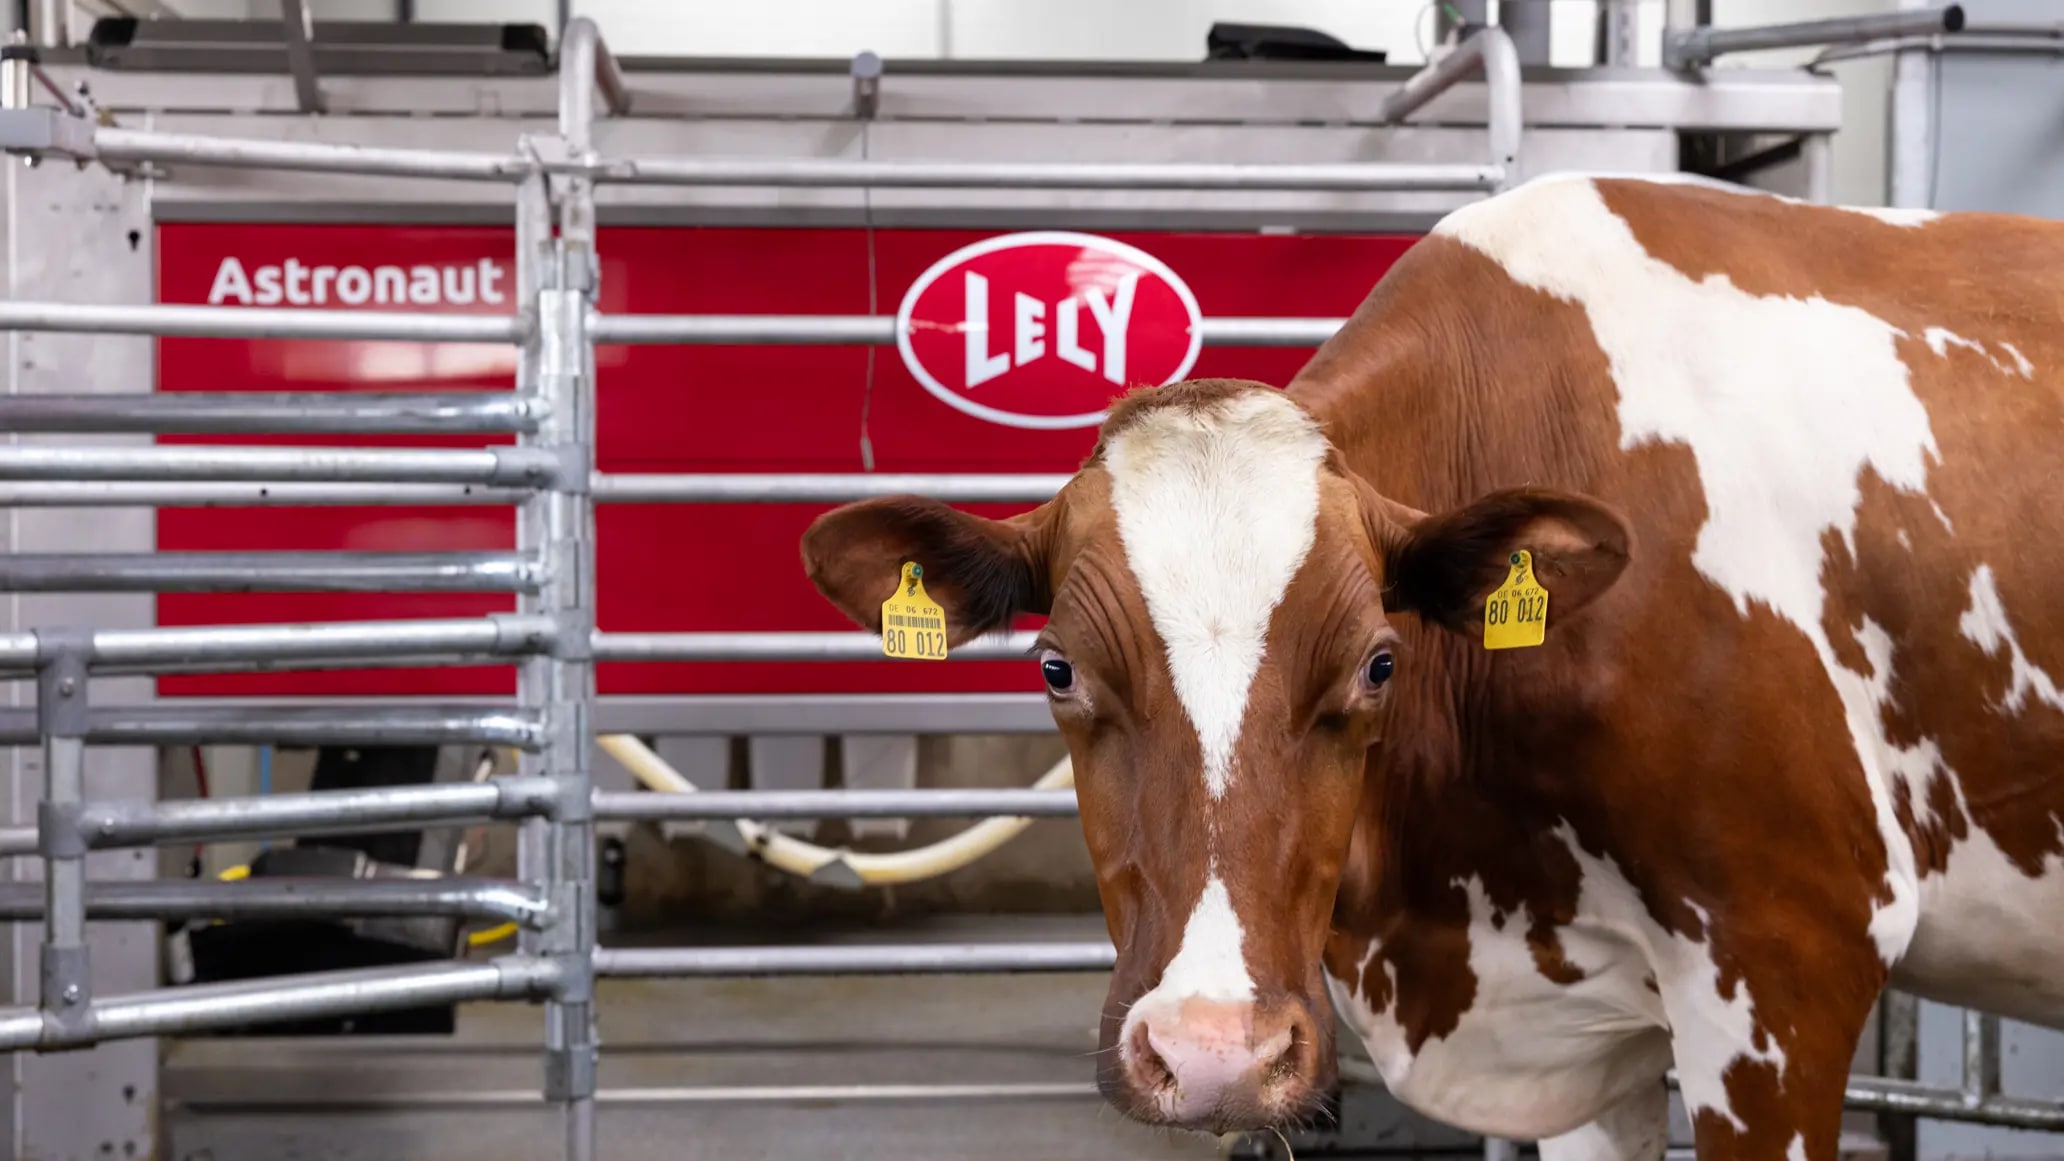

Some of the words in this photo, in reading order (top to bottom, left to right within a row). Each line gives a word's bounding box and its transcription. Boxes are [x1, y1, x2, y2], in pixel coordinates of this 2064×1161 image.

[207, 256, 505, 305] Astronaut
[965, 269, 1139, 389] LELY
[889, 604, 898, 613] DE
[906, 605, 917, 614] 06
[923, 607, 938, 616] 672
[1488, 599, 1509, 625] 80
[1517, 596, 1544, 623] 012
[887, 628, 906, 655] 80
[916, 631, 945, 657] 012
